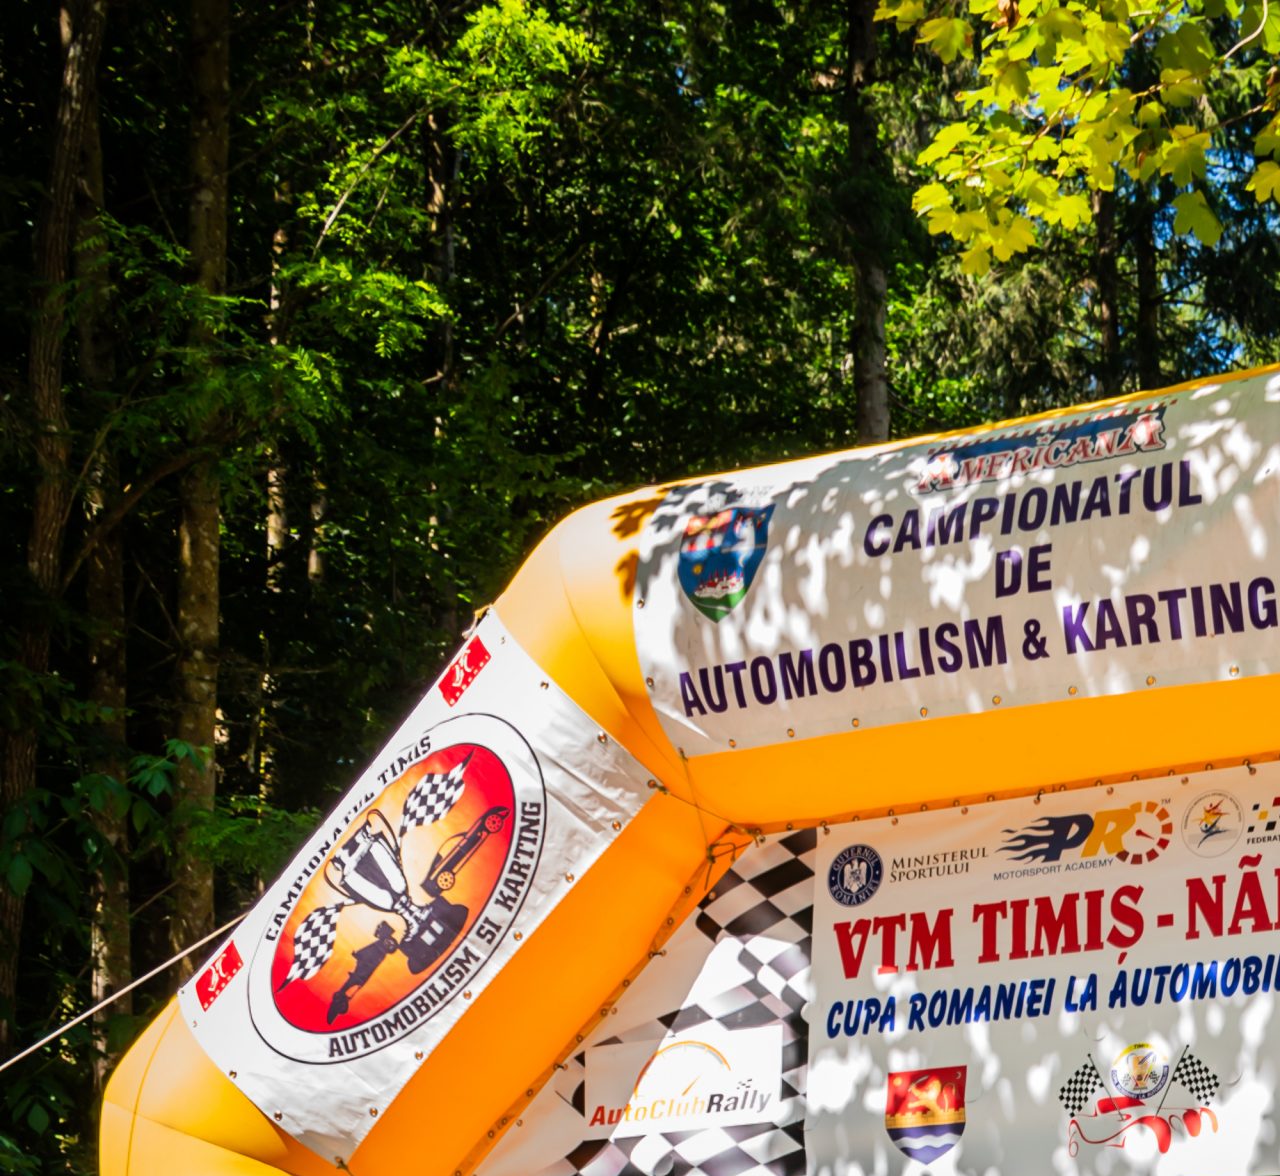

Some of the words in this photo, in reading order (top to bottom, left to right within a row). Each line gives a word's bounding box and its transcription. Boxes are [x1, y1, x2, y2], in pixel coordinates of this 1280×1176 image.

[863, 459, 1203, 558] CAMPIONATUL
[994, 543, 1053, 599] DE
[678, 613, 1007, 718] AUTOMOBILISM
[1022, 619, 1050, 660] &
[1063, 577, 1277, 655] KARTING
[377, 735, 432, 786] TIMIS
[832, 846, 880, 872] GUVERNUL
[890, 861, 970, 883] SPORTULUI
[891, 846, 989, 869] MINISTERUL
[993, 863, 1062, 881] MOTORSPORT
[1064, 858, 1114, 872] ACADEMY
[328, 946, 482, 1058] AUTOMOBILISM
[476, 917, 502, 946] SI
[495, 800, 542, 914] KARTING
[833, 907, 955, 980] VTM
[826, 997, 895, 1039] CUPA
[907, 977, 1056, 1032] ROMANIEI
[1066, 974, 1098, 1013] LA
[588, 1088, 773, 1128] AutoClubRally
